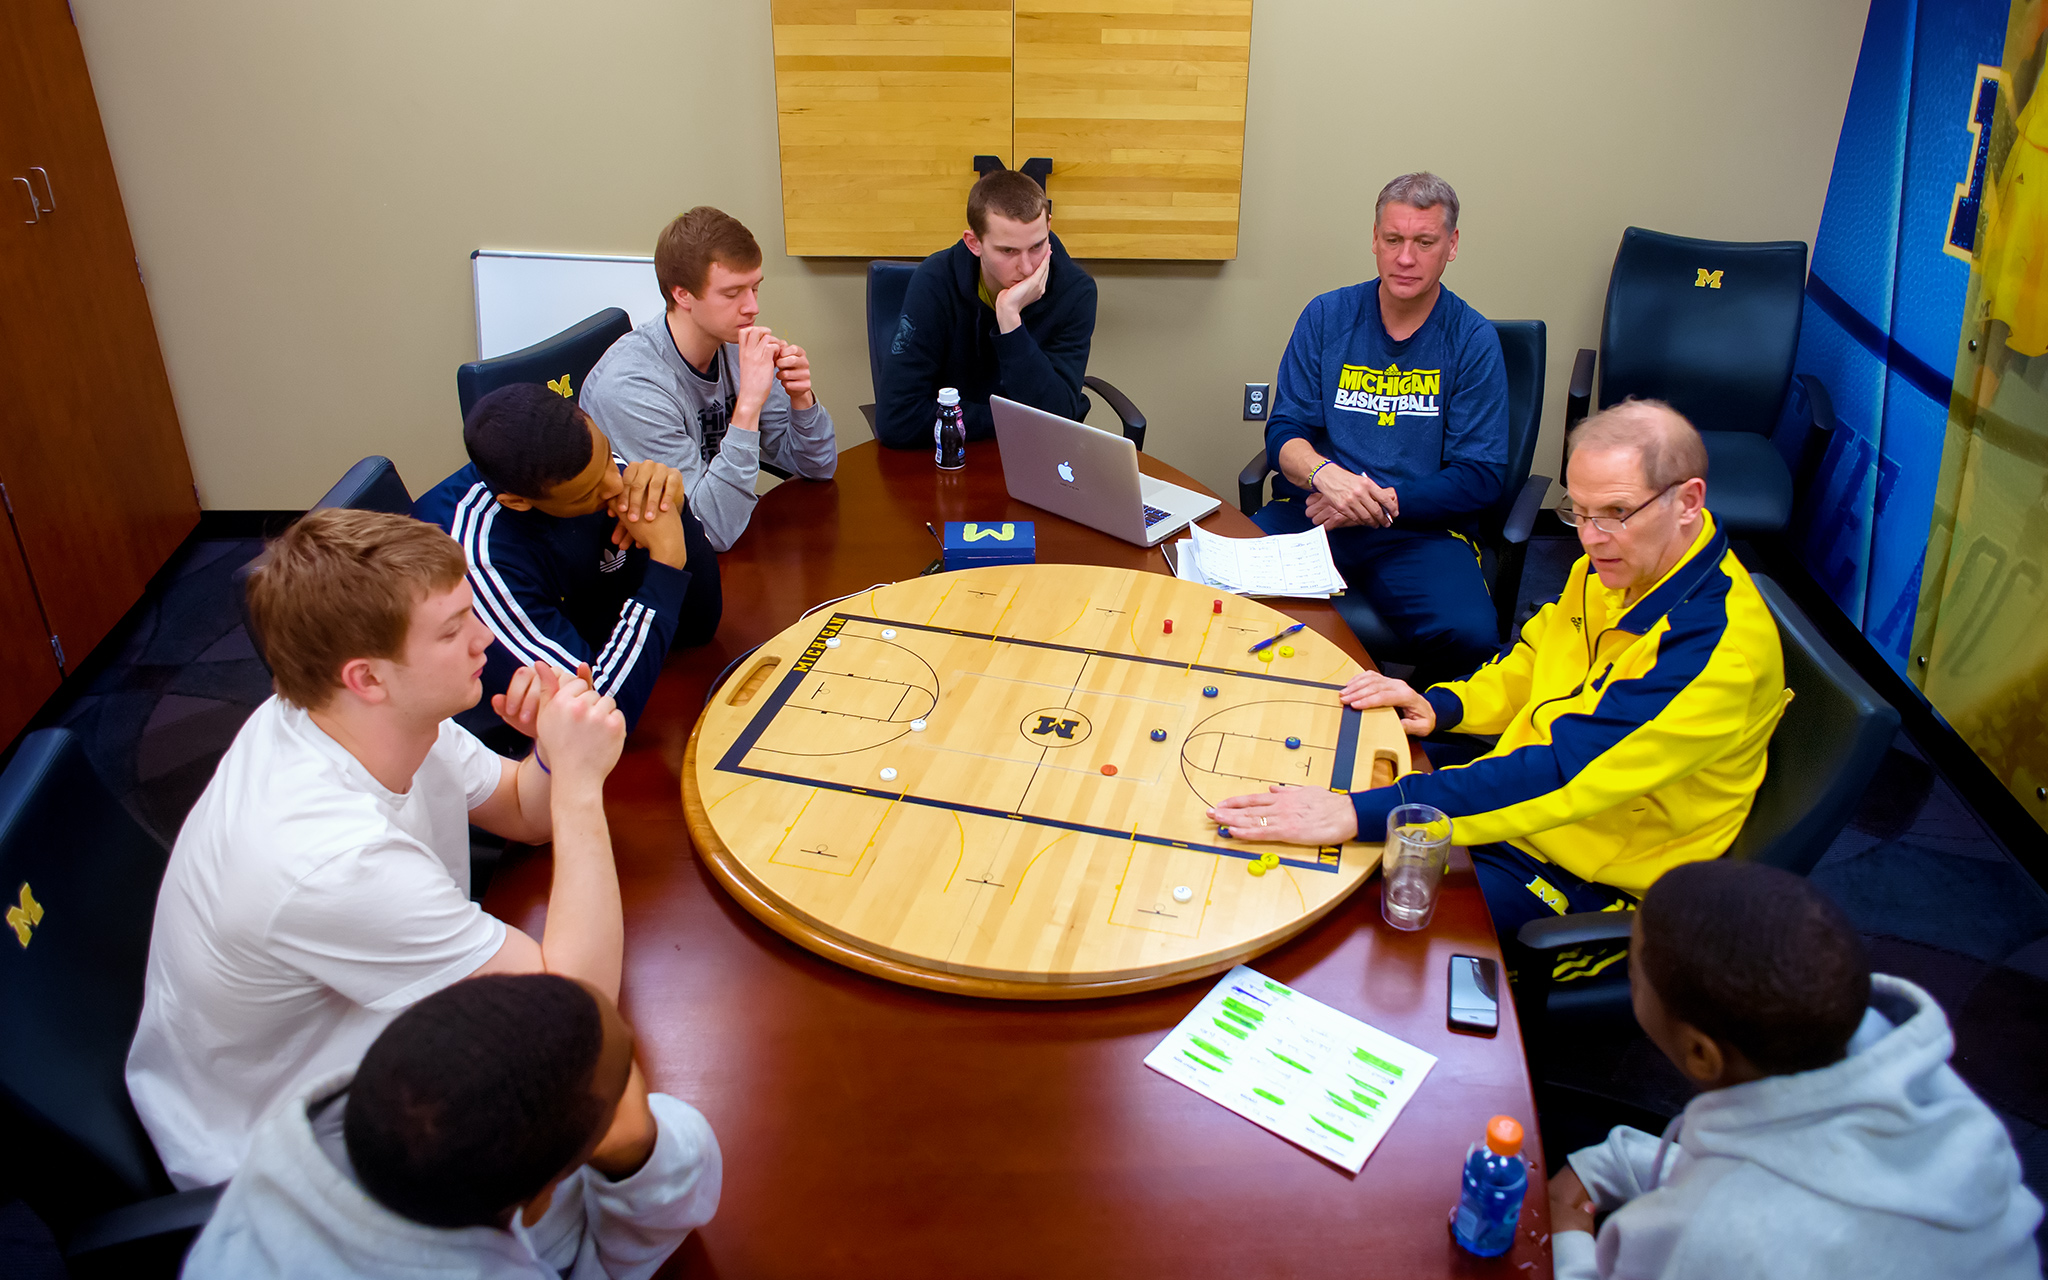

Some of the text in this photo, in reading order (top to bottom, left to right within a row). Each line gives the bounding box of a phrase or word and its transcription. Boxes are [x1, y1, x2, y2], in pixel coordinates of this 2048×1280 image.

[1695, 268, 1724, 289] M
[547, 374, 574, 398] M
[1338, 368, 1441, 396] MICHIGAN
[1335, 388, 1439, 411] BASKETBALL
[1377, 411, 1396, 426] M
[793, 616, 847, 673] MICHIGAN
[1031, 715, 1080, 740] M
[6, 882, 45, 948] M
